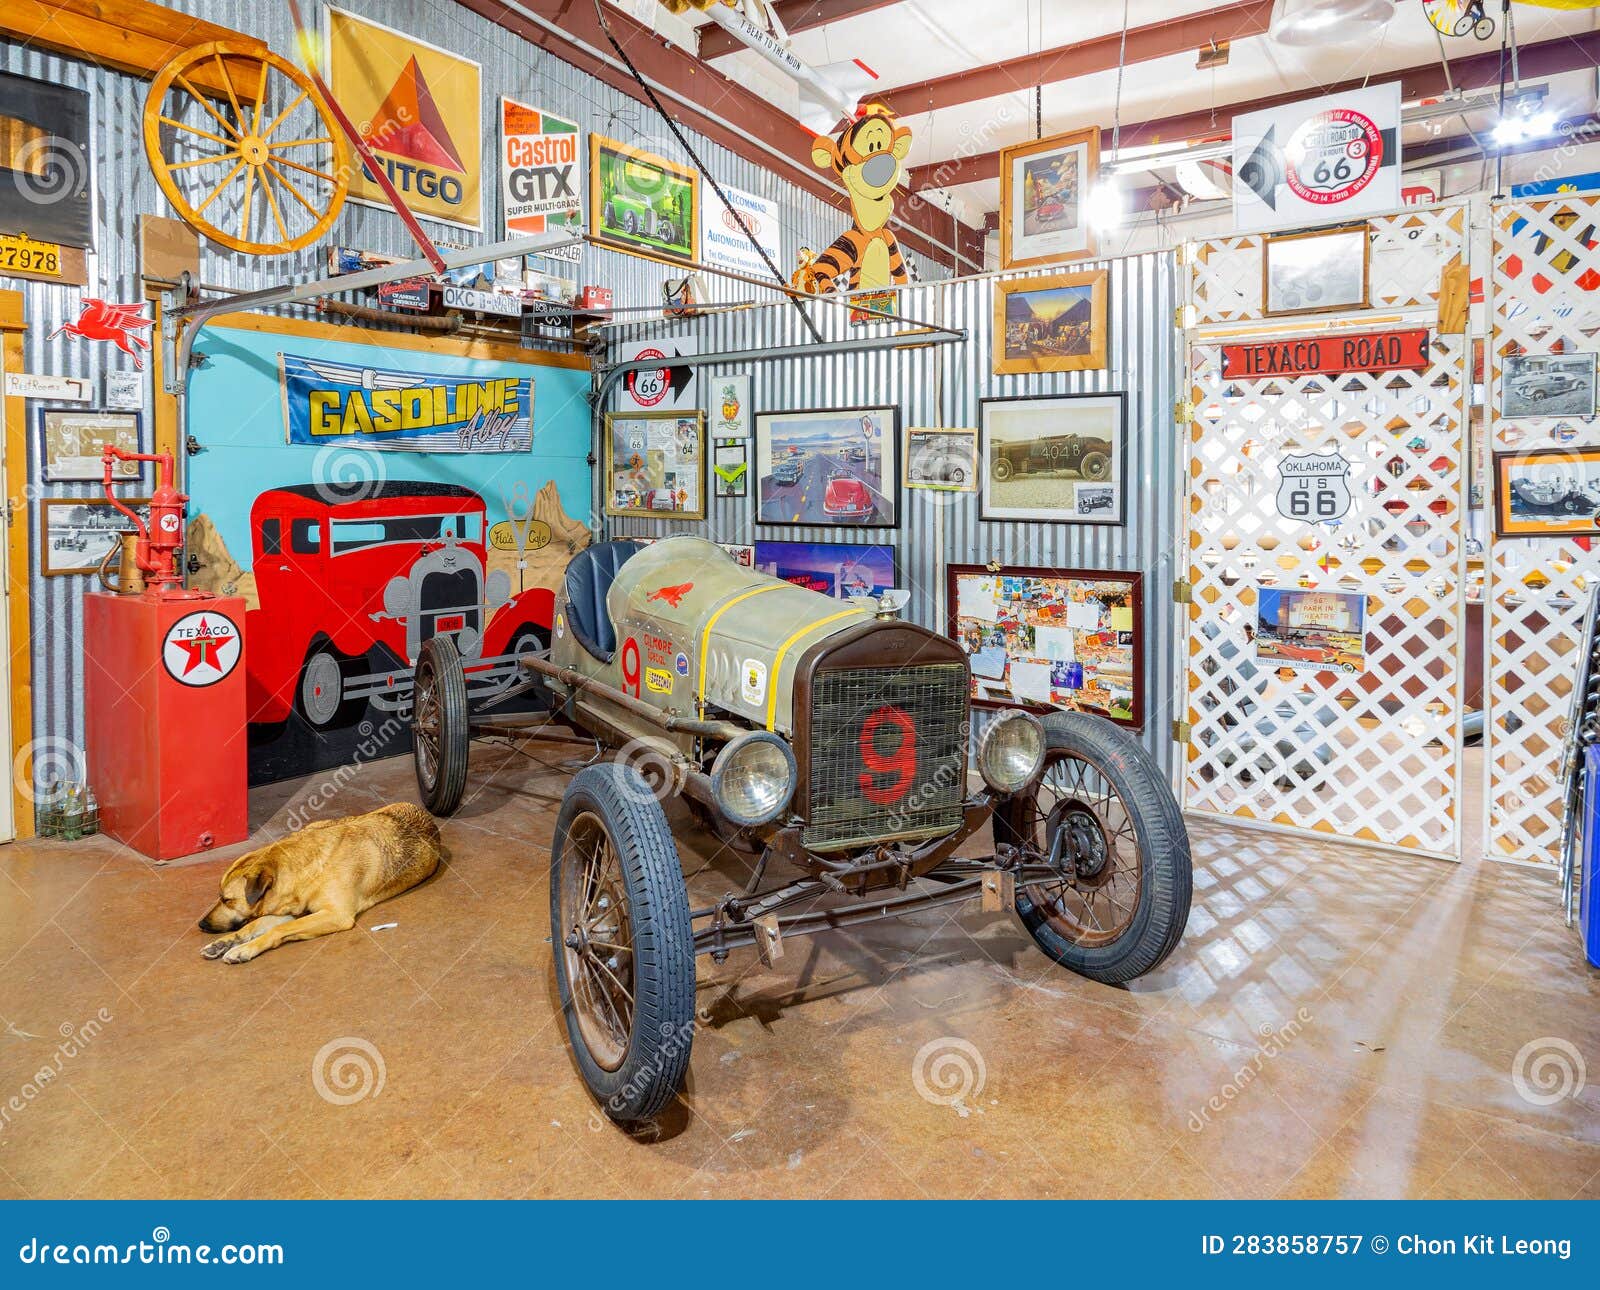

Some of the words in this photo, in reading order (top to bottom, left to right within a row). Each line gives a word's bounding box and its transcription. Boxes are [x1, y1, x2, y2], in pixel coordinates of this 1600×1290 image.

[764, 37, 773, 49] TO
[773, 43, 784, 58] THE
[507, 134, 575, 168] Castrol
[1353, 143, 1361, 155] 3
[361, 155, 463, 206] CITGO
[1313, 157, 1351, 183] 66
[509, 165, 575, 203] GTX
[507, 204, 533, 216] SUPER
[534, 199, 580, 213] MULTI-GRADE
[707, 229, 749, 251] AUTOMOTIVE
[446, 288, 475, 308] OKC
[1243, 342, 1320, 375] TEXACO
[1343, 336, 1402, 367] ROAD
[641, 379, 657, 393] 66
[309, 377, 520, 436] GASOLINE
[457, 406, 519, 450] Alley
[632, 440, 642, 449] 66
[682, 444, 693, 455] 64
[1285, 459, 1343, 473] OKLAHOMA
[1291, 489, 1337, 516] 66
[529, 529, 547, 548] Cafe
[177, 625, 230, 639] TEXACO
[860, 705, 917, 805] 9
